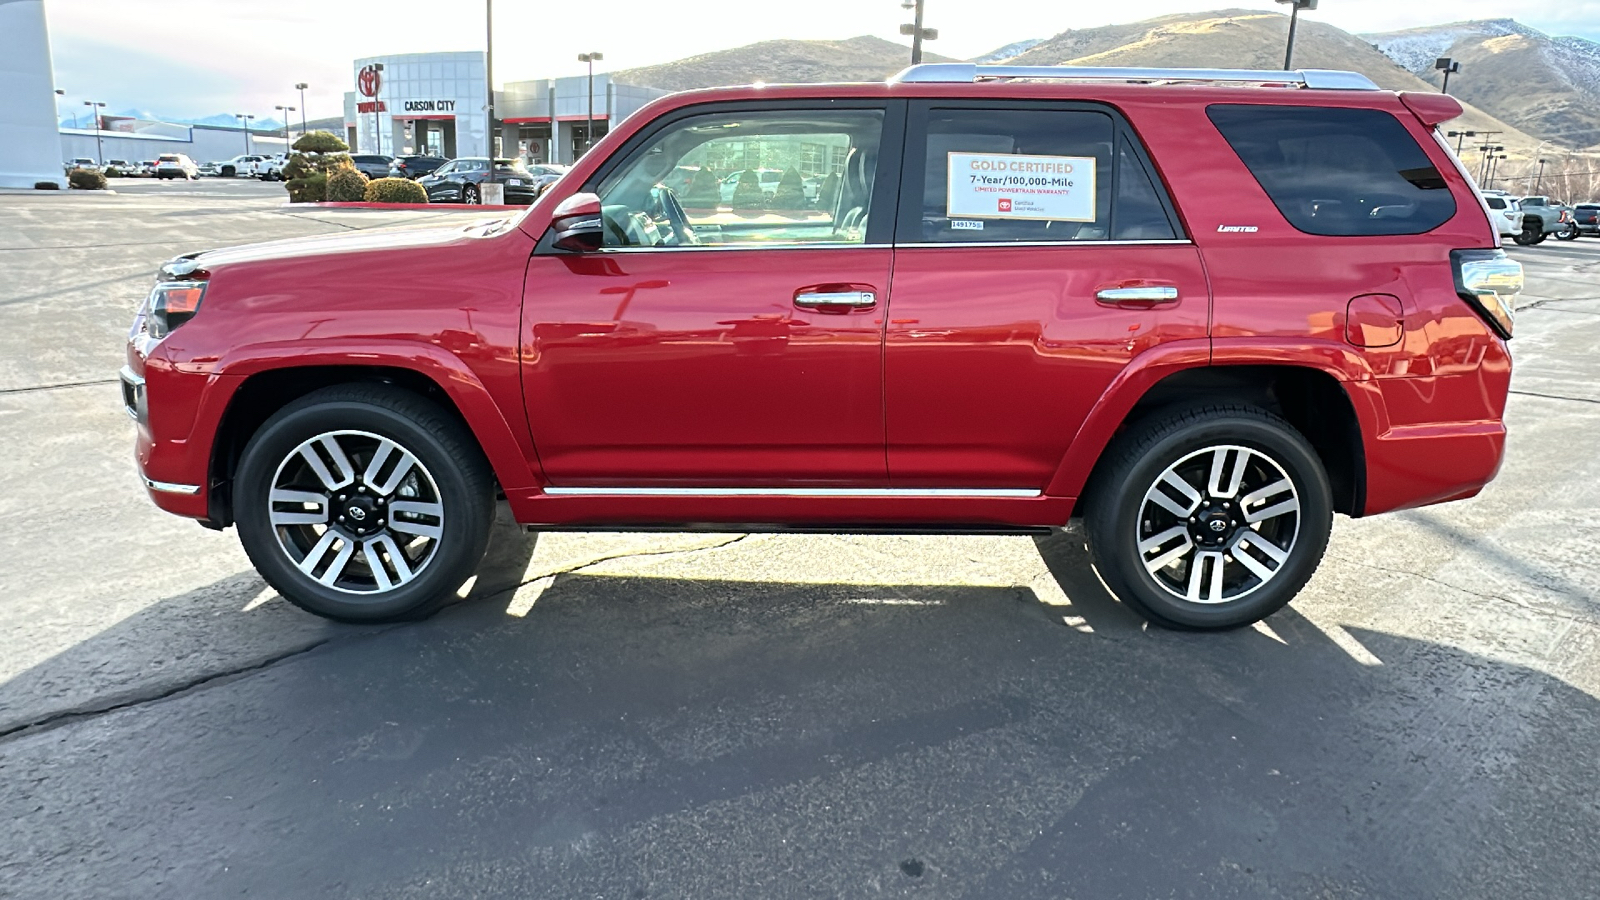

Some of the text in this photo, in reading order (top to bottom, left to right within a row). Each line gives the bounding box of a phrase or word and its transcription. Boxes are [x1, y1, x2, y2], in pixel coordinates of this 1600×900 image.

[404, 100, 455, 112] CARSON CITY
[970, 160, 1073, 174] GOLD CERTIFIED
[970, 175, 1073, 187] 7-Year/100,000-Mile
[998, 187, 1036, 195] POWERTRAIN
[1037, 188, 1069, 196] WARRANTY
